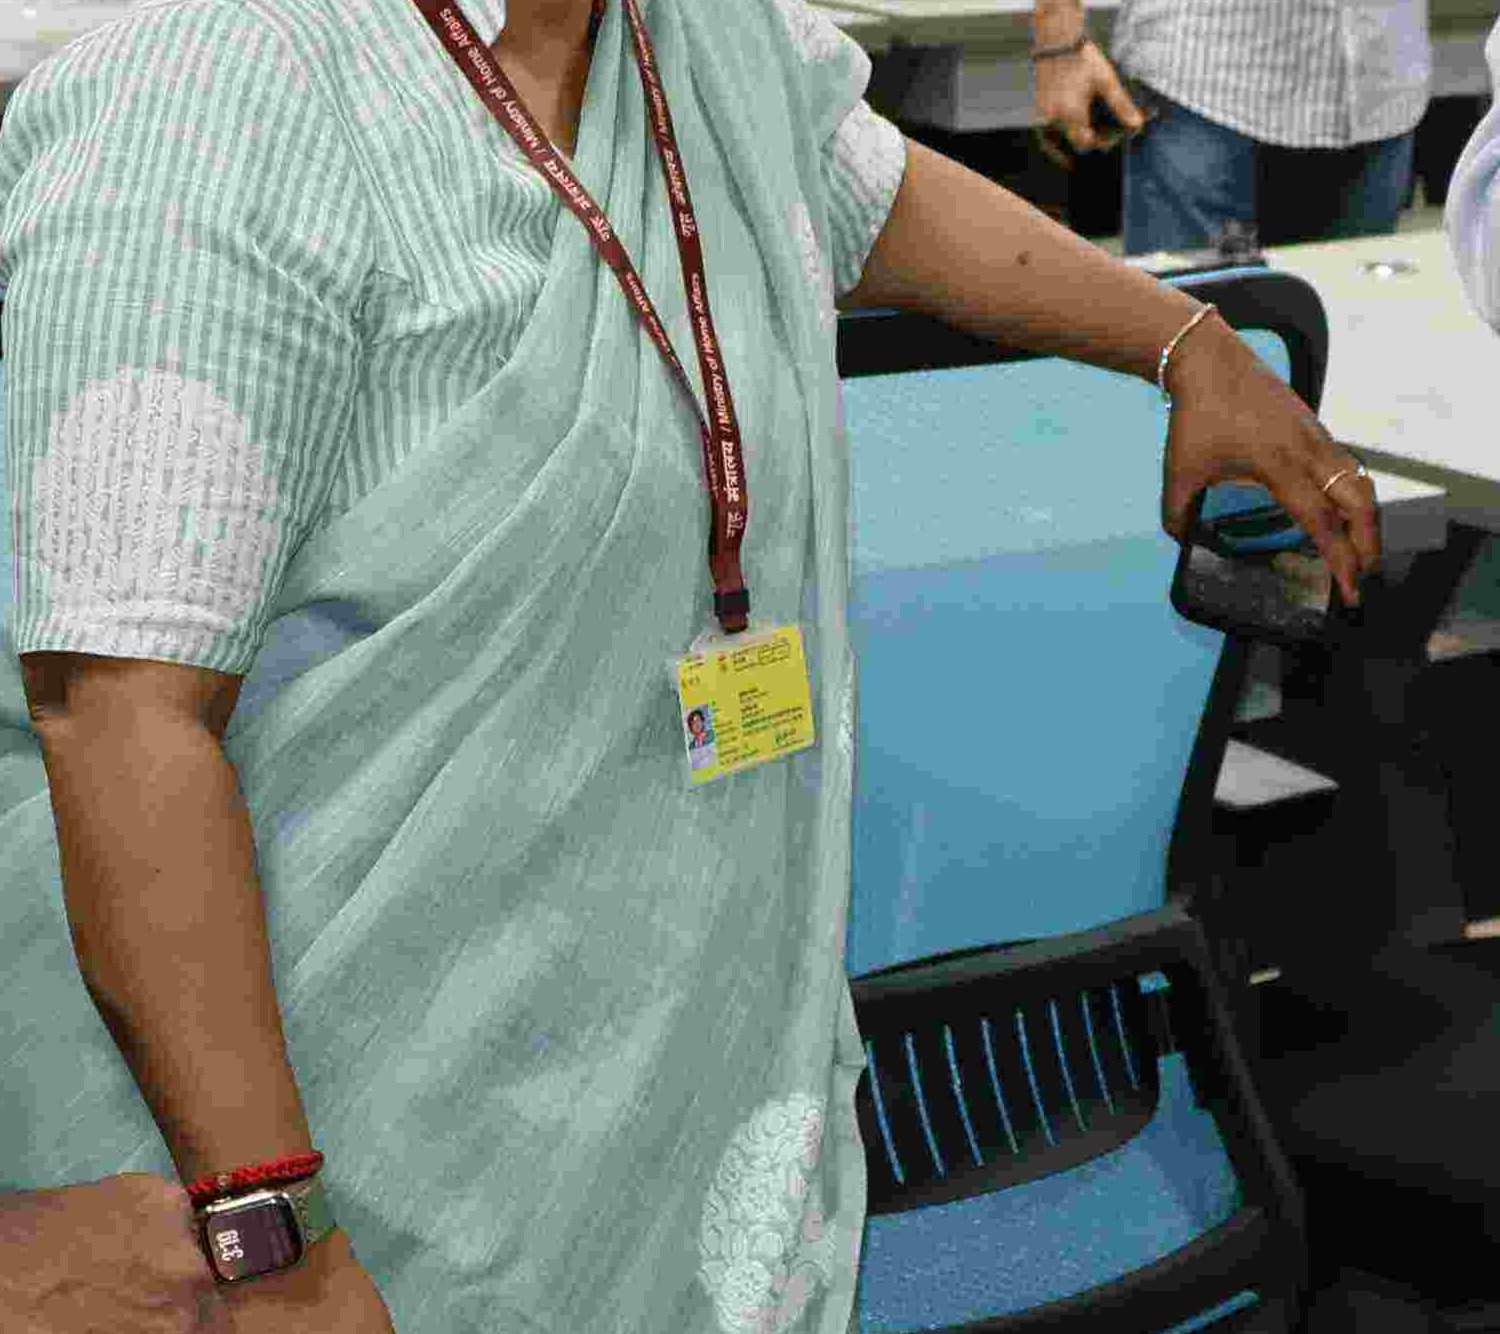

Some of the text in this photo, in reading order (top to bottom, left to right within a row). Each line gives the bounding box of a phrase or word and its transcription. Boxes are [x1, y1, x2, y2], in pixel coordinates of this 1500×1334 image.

[439, 8, 472, 48] Affairs
[467, 47, 497, 87] Home
[489, 86, 507, 100] of
[501, 99, 541, 148] Ministry
[692, 272, 705, 315] Affairs
[699, 315, 717, 354] Home
[712, 373, 731, 424] Ministry
[722, 440, 741, 503] मंत्रालय
